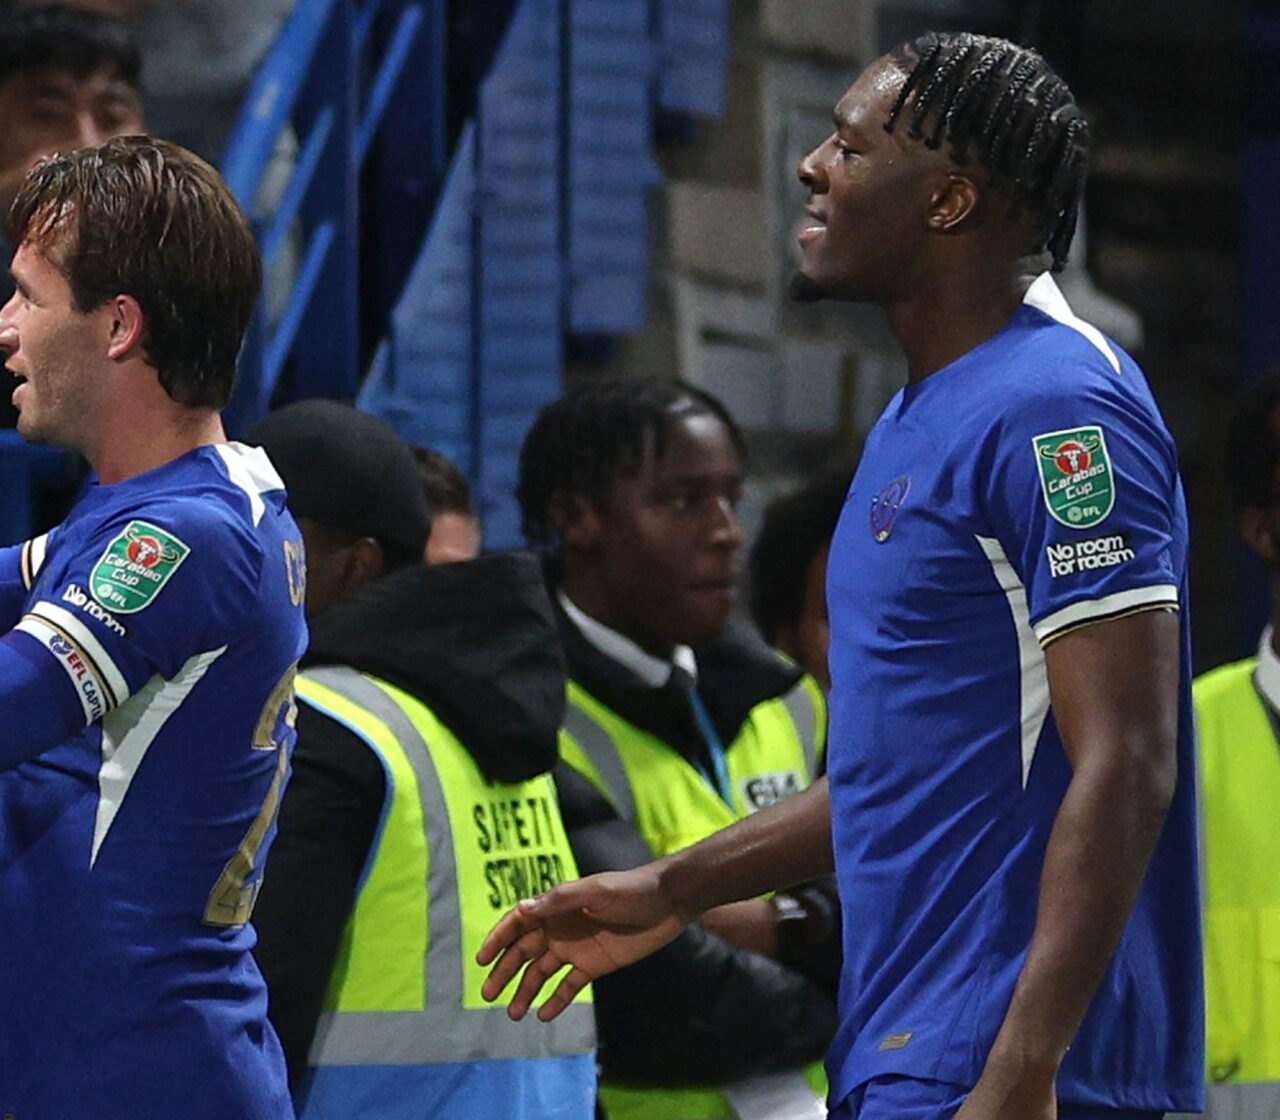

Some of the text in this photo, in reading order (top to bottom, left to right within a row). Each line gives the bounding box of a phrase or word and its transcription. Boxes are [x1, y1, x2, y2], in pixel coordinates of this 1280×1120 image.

[1048, 462, 1106, 494] Carabao
[1065, 482, 1093, 500] Cup
[1082, 506, 1101, 518] EFL
[1046, 535, 1124, 564] No room
[1078, 547, 1135, 572] racism
[105, 552, 162, 584] Carabao
[111, 567, 140, 587] Cup
[62, 583, 128, 638] No room
[110, 592, 128, 608] EFL
[66, 649, 88, 682] EFL
